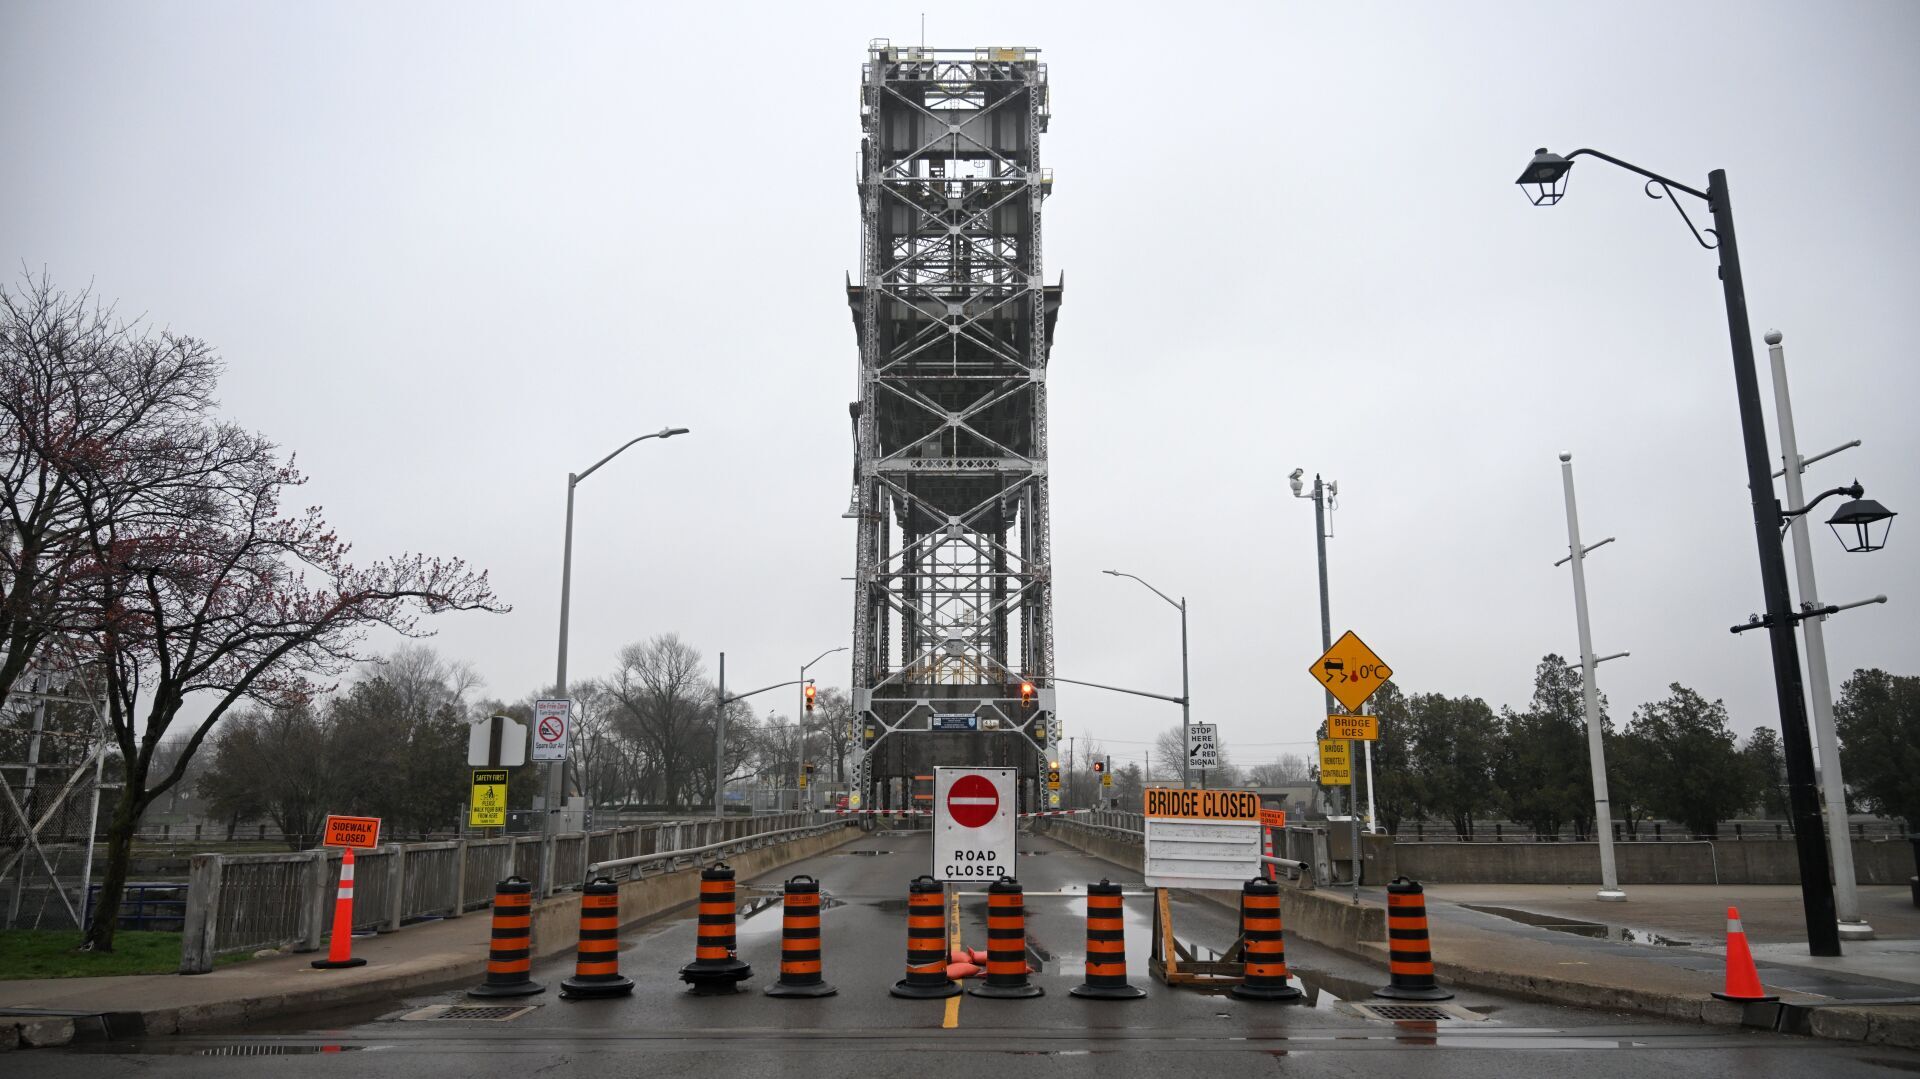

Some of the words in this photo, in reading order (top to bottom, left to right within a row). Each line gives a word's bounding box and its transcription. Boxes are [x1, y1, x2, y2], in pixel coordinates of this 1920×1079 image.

[1335, 718, 1370, 728] BRIDGE
[1342, 728, 1364, 737] ICES
[536, 742, 548, 750] Spare
[1324, 744, 1344, 752] BRIDGE
[1149, 791, 1199, 816] BRIDGE
[1203, 792, 1256, 818] CLOSED
[332, 822, 372, 832] SIDEWALK
[336, 833, 366, 842] CLOSED
[955, 850, 996, 861] ROAD
[945, 865, 1006, 876] CLOSED
